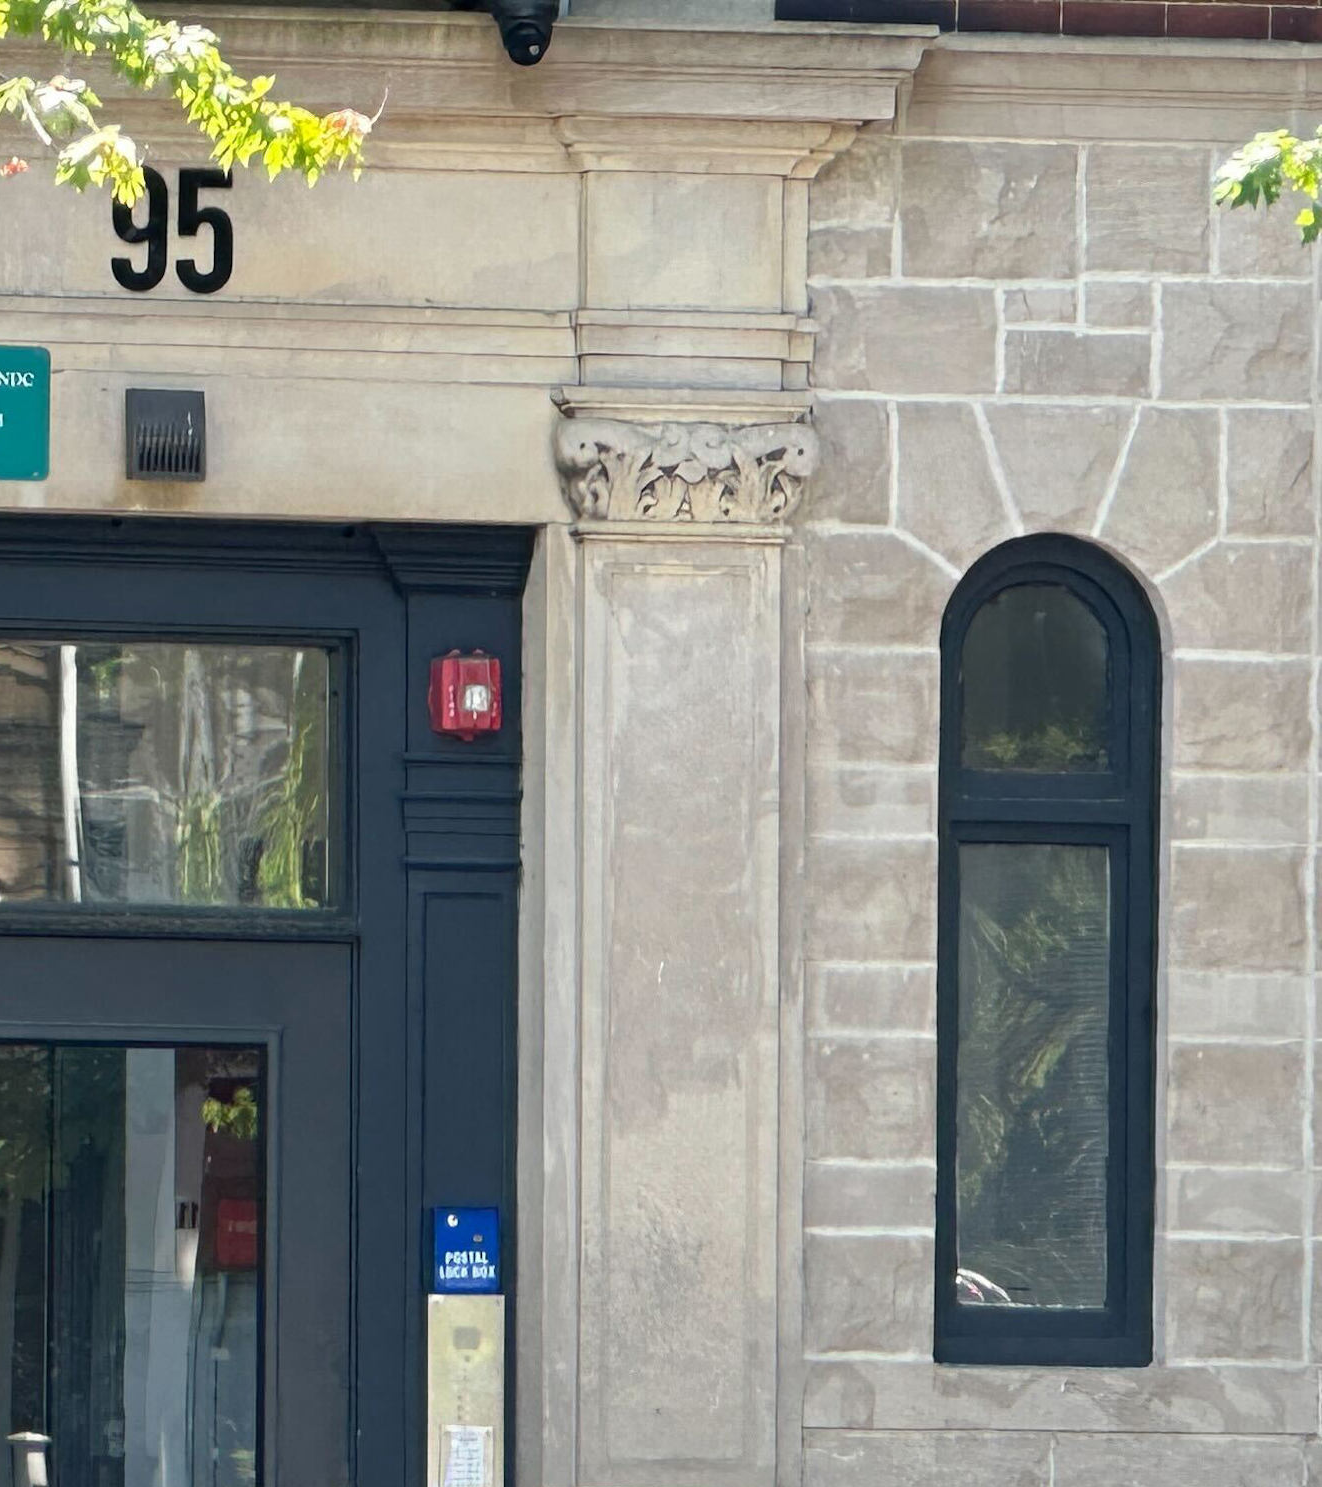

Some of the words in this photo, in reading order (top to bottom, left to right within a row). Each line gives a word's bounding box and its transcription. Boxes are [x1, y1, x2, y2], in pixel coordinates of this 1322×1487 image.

[111, 165, 234, 294] 95
[445, 1250, 489, 1265] POSTAL
[472, 1264, 496, 1279] BOX
